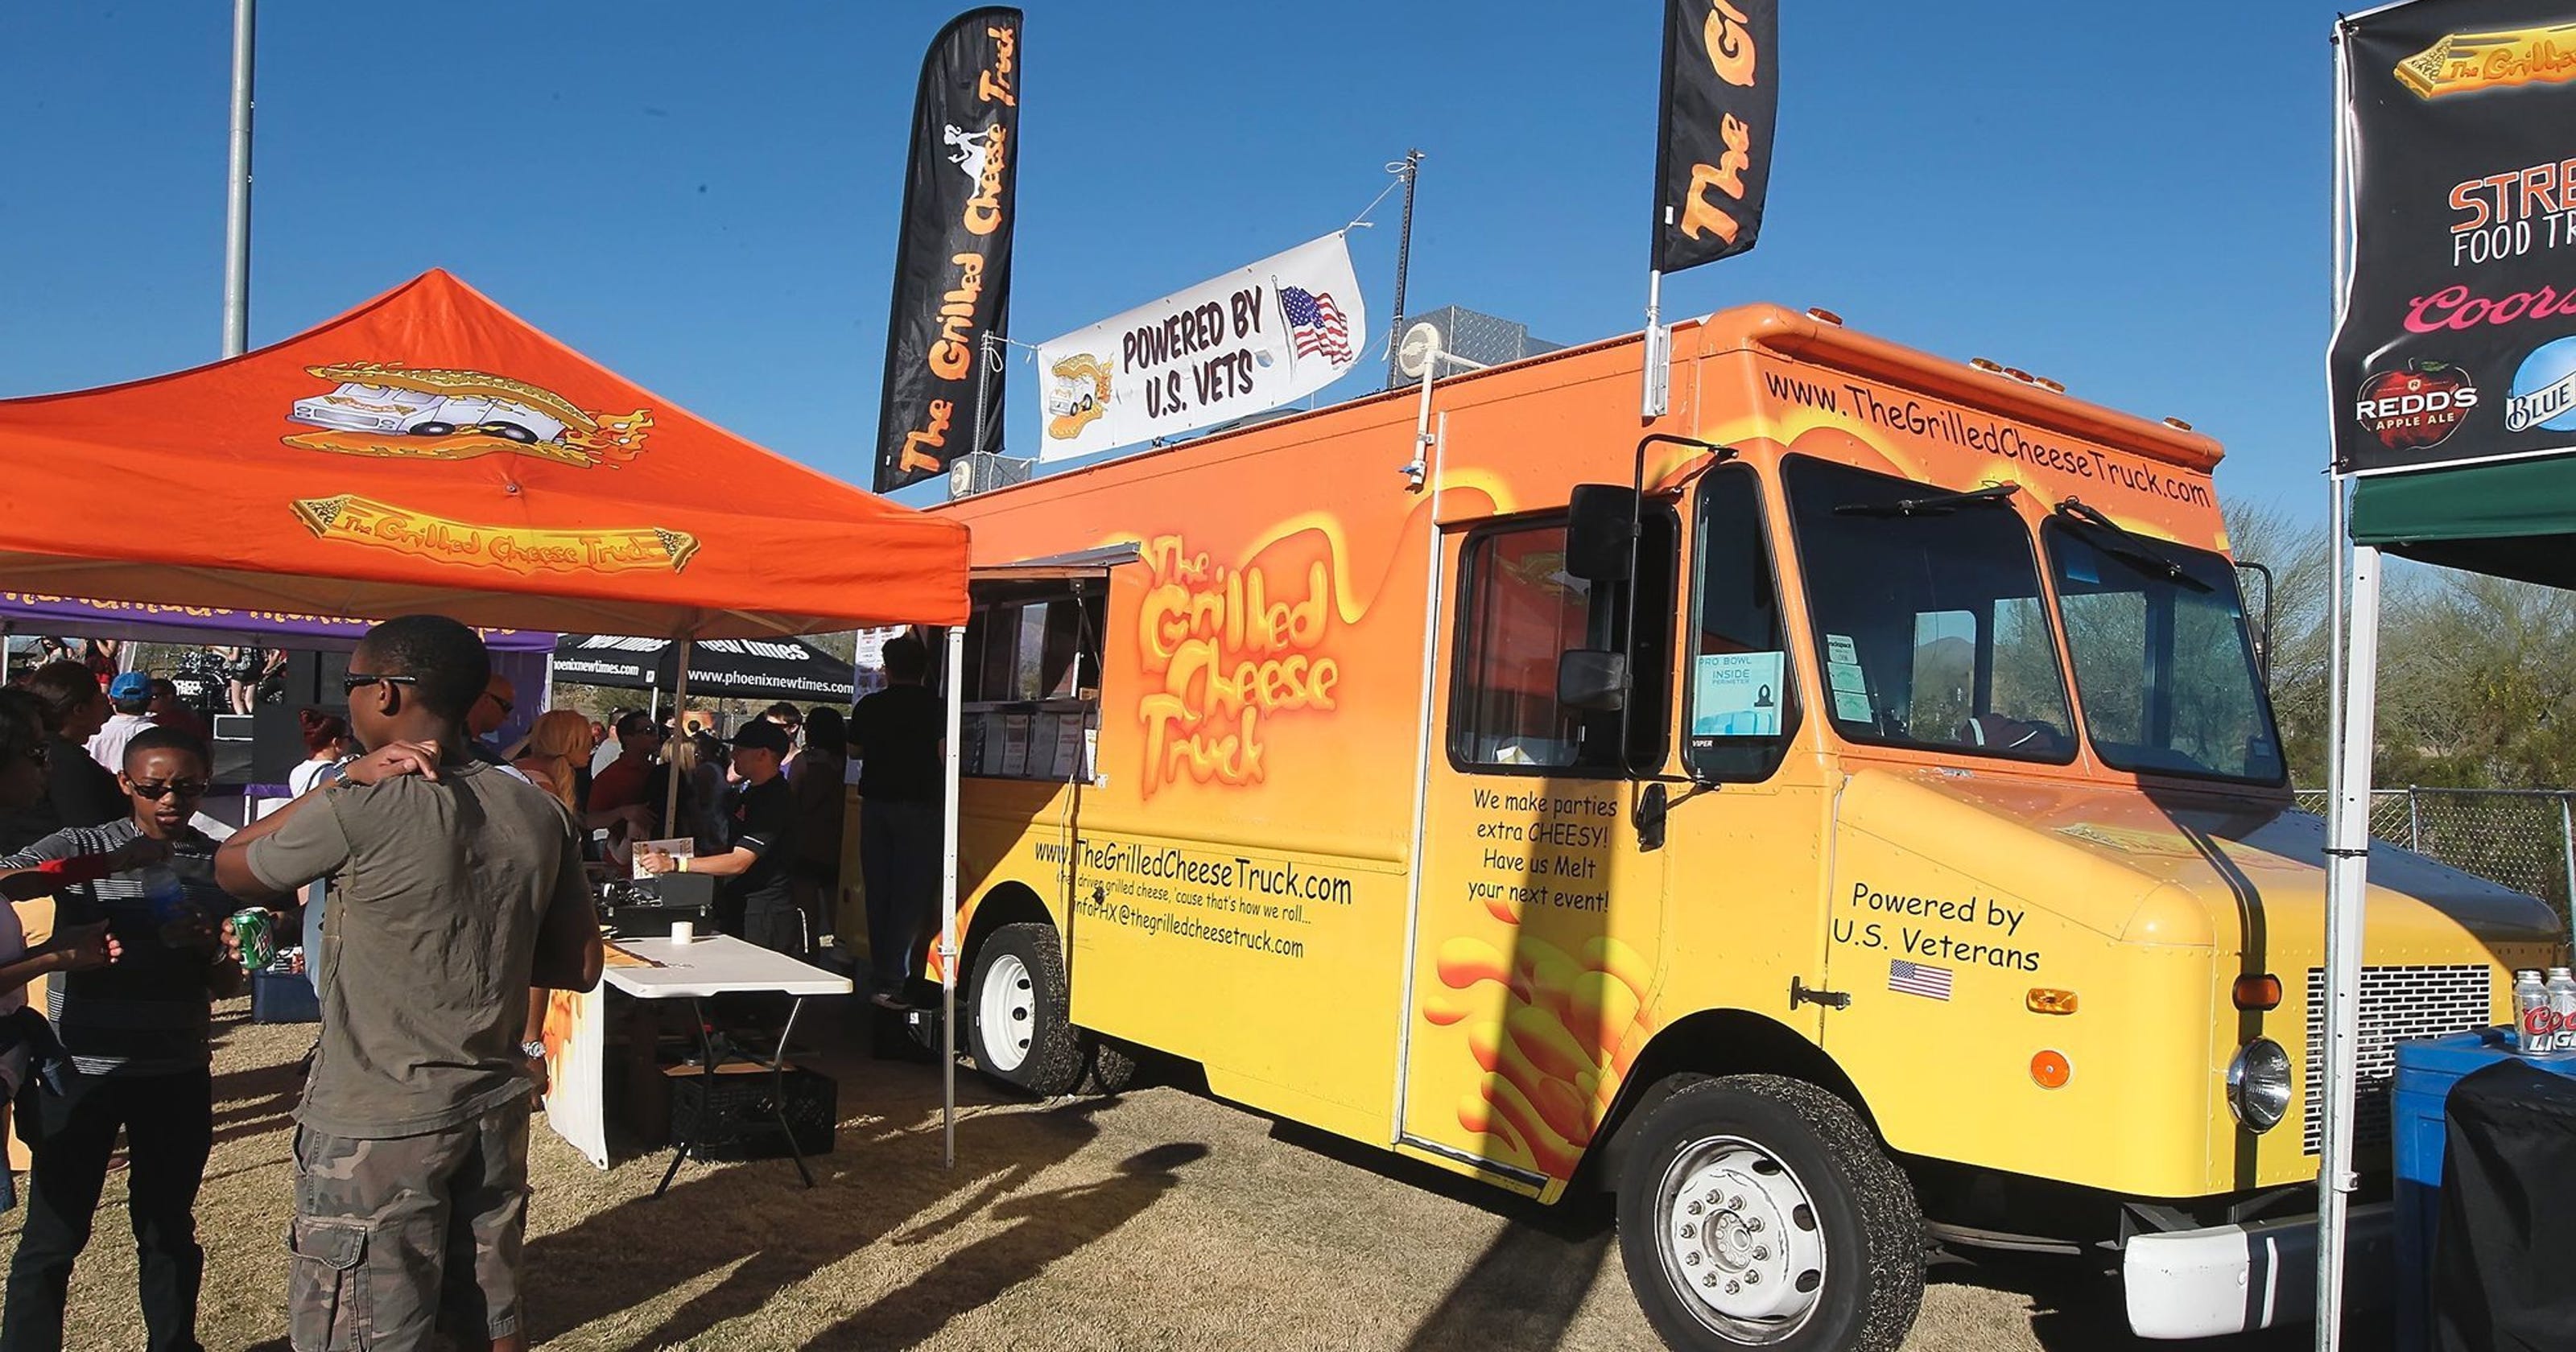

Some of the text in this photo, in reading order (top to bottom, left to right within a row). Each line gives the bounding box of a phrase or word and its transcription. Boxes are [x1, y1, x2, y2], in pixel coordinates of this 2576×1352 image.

[2451, 61, 2479, 78] The
[1681, 113, 1750, 245] The
[899, 27, 1016, 472] The Grilled Cheese Truck
[2454, 221, 2531, 266] FOOD
[1123, 285, 1262, 373] POWERED BY
[1146, 348, 1254, 418] U.S. VETS
[2356, 383, 2479, 421] REDD'S
[1765, 371, 2211, 508] www.TheGrilledCheeseTruck.com
[2376, 413, 2454, 431] APPLE ALE
[344, 516, 656, 566] The Grilled Cheese Truck
[1153, 534, 1210, 589] The
[1139, 559, 1328, 674] Grilled
[687, 670, 854, 695] www.phoenixnewtimes.com
[1166, 637, 1340, 727] Cheese
[1699, 657, 1752, 666] PRO BOWL
[1713, 669, 1750, 679] INSIDE
[1138, 693, 1265, 802] Truck
[1692, 740, 1713, 748] VIPER
[1474, 789, 1617, 819] We make parties
[1477, 821, 1608, 848] extra CHEESY!
[1484, 848, 1596, 879] Have us Melt
[1106, 879, 1134, 896] grilled
[1137, 883, 1171, 904] cheese,
[1207, 892, 1236, 912] that's
[1239, 897, 1261, 916] how
[1264, 906, 1278, 919] we
[1282, 905, 1311, 924] roll...
[1468, 882, 1609, 913] your next event!
[1852, 882, 2025, 937] Powered by
[1833, 918, 2040, 971] U.S. Veterans
